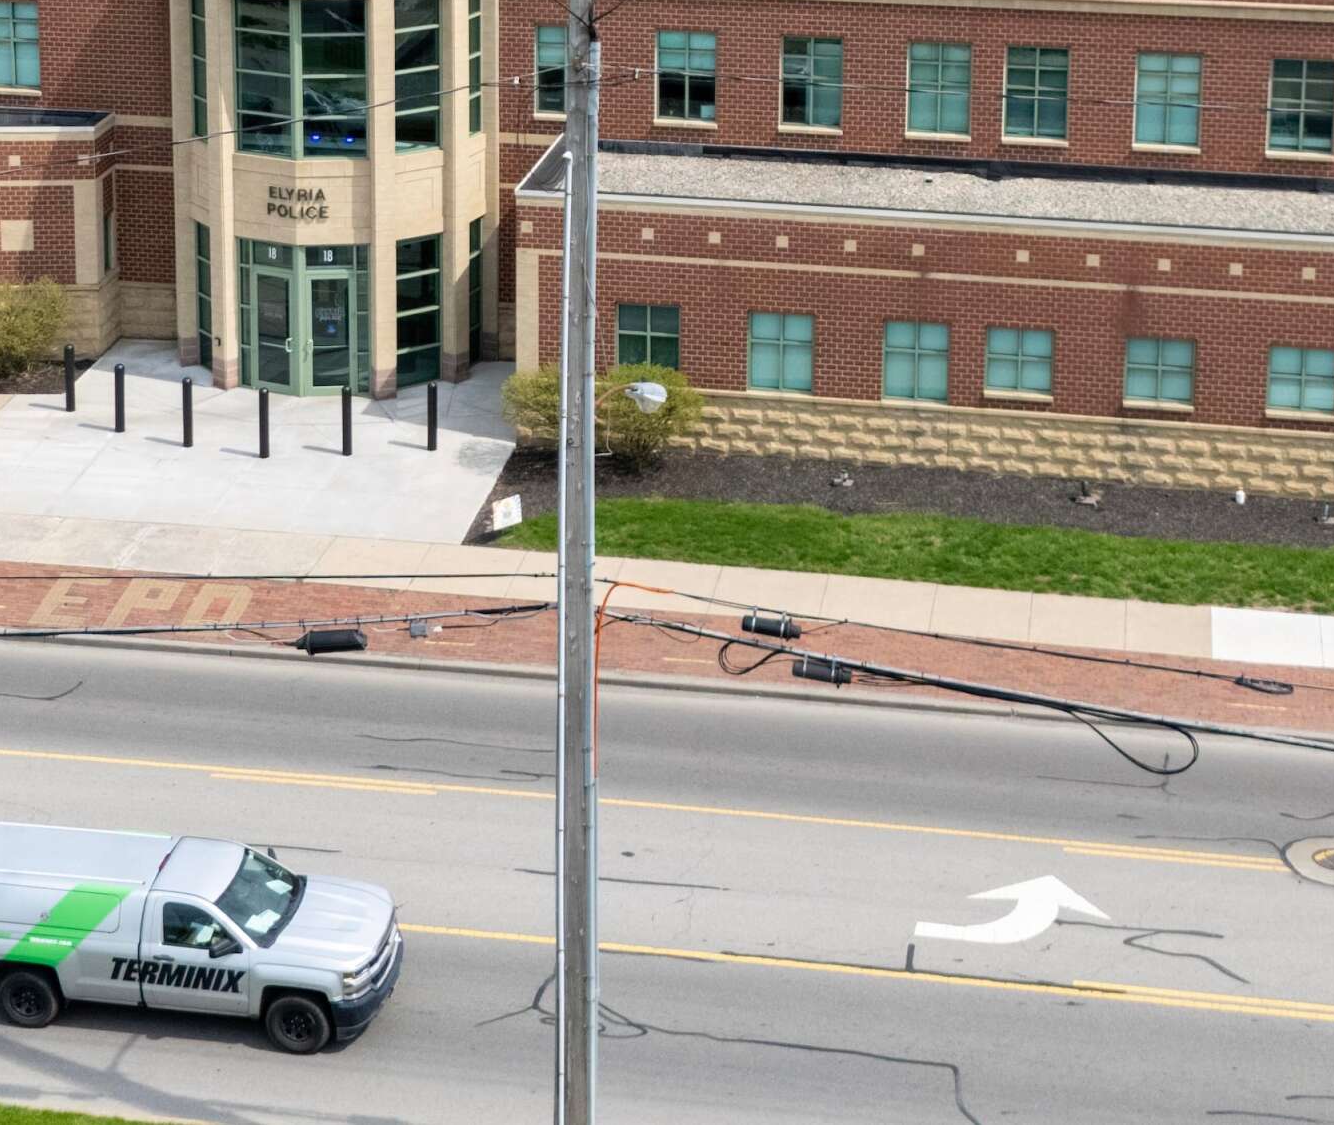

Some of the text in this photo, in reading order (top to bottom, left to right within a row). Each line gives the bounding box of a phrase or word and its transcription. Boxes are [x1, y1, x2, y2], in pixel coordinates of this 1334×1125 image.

[268, 185, 325, 201] ELYRIA
[267, 202, 329, 219] POLICE
[322, 249, 333, 262] 18
[27, 572, 253, 627] EPD
[110, 957, 246, 993] TERMINIX
